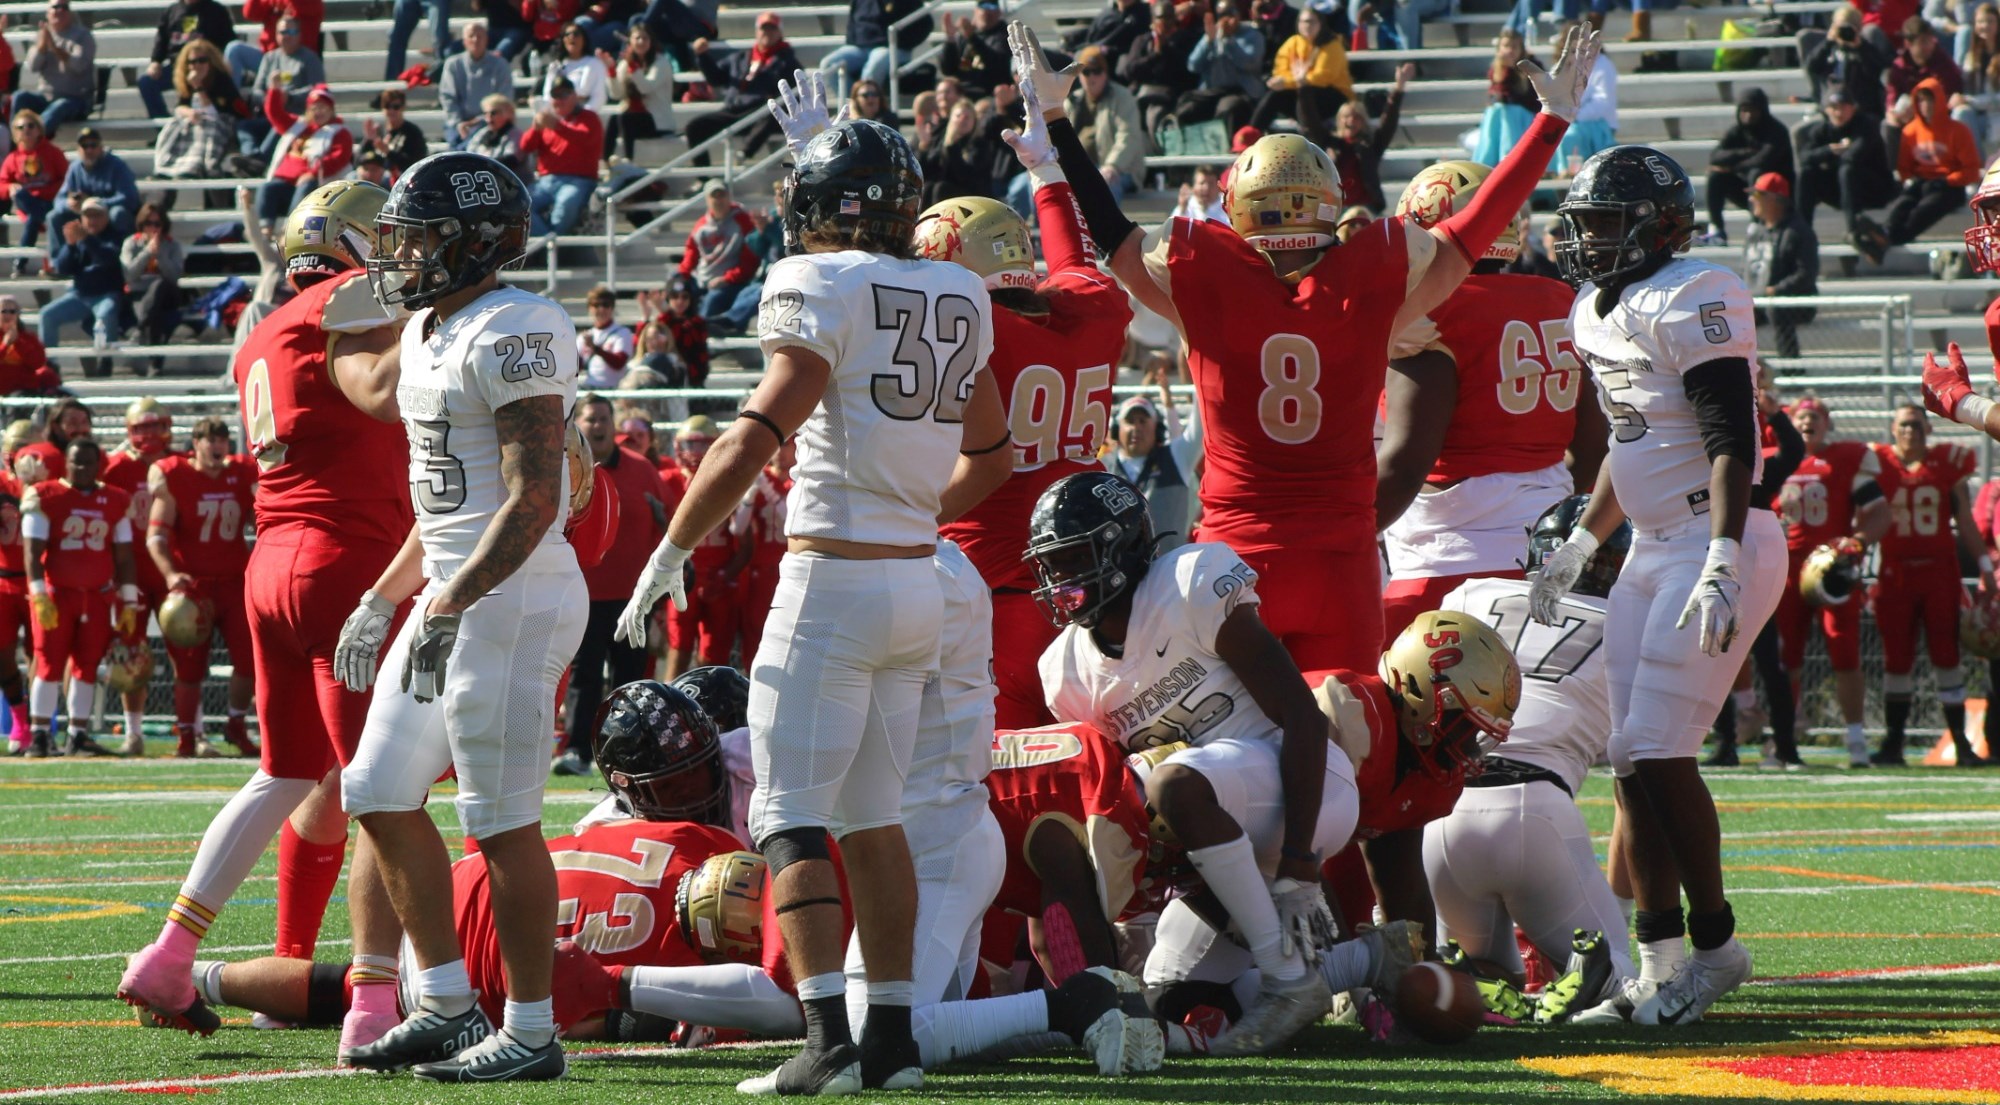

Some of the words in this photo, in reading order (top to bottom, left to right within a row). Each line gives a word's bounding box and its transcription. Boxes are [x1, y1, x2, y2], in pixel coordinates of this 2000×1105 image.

[451, 170, 501, 209] 23
[1644, 155, 1672, 186] 5
[1260, 236, 1317, 249] Riddell
[1485, 245, 1517, 260] Ridde
[1699, 301, 1732, 344] 5
[494, 332, 557, 383] 23
[870, 283, 980, 423] 32
[1496, 319, 1582, 415] 65
[1258, 333, 1323, 444] 8
[245, 358, 289, 473] 9
[1007, 363, 1110, 473] 95
[1091, 477, 1139, 516] 25
[60, 515, 109, 551] 23
[197, 500, 241, 543] 78
[1423, 630, 1464, 670] 50
[1489, 594, 1607, 684] 17
[1104, 657, 1208, 736] STEVENSON
[550, 837, 676, 956] 73
